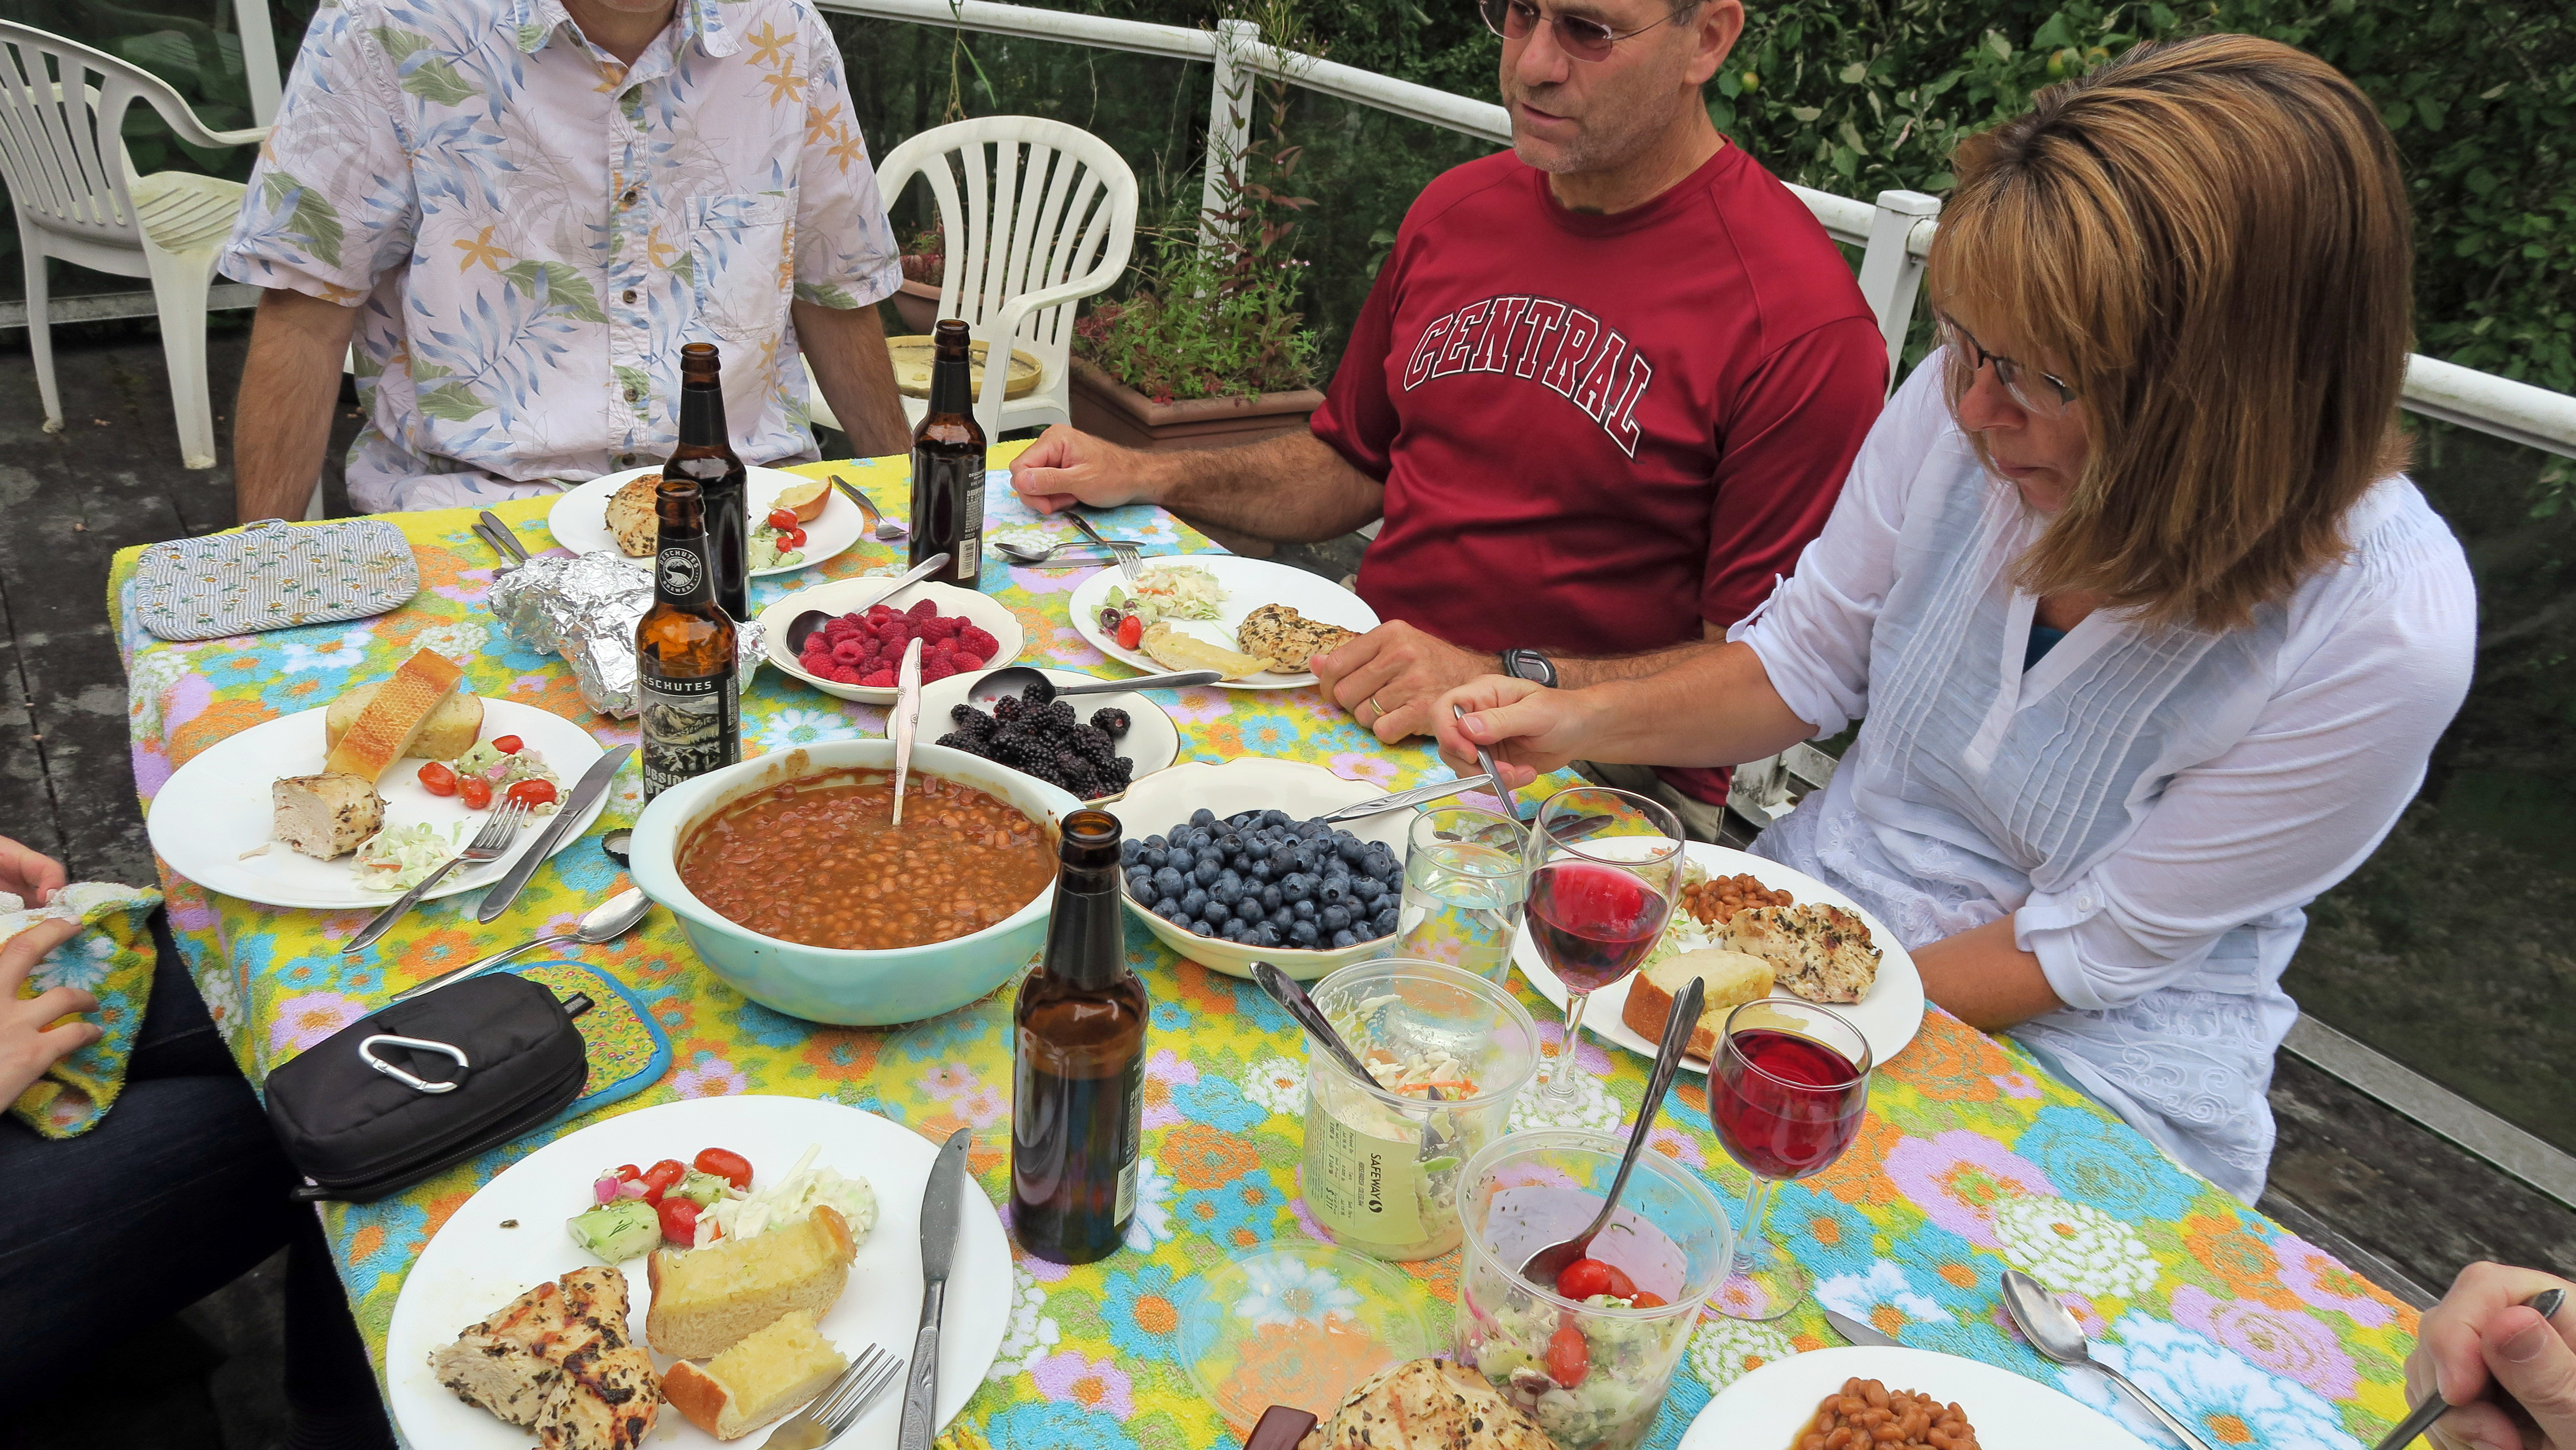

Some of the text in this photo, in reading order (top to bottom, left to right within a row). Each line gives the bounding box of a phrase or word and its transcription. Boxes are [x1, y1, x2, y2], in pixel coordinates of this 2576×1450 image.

[1403, 295, 1653, 460] CENTRAL
[659, 550, 699, 568] DESCHUTES
[662, 580, 695, 593] BREWERY
[638, 671, 712, 692] DESCHUTES
[645, 764, 687, 785] OBSID
[1370, 1153, 1382, 1200] SAFEWAY
